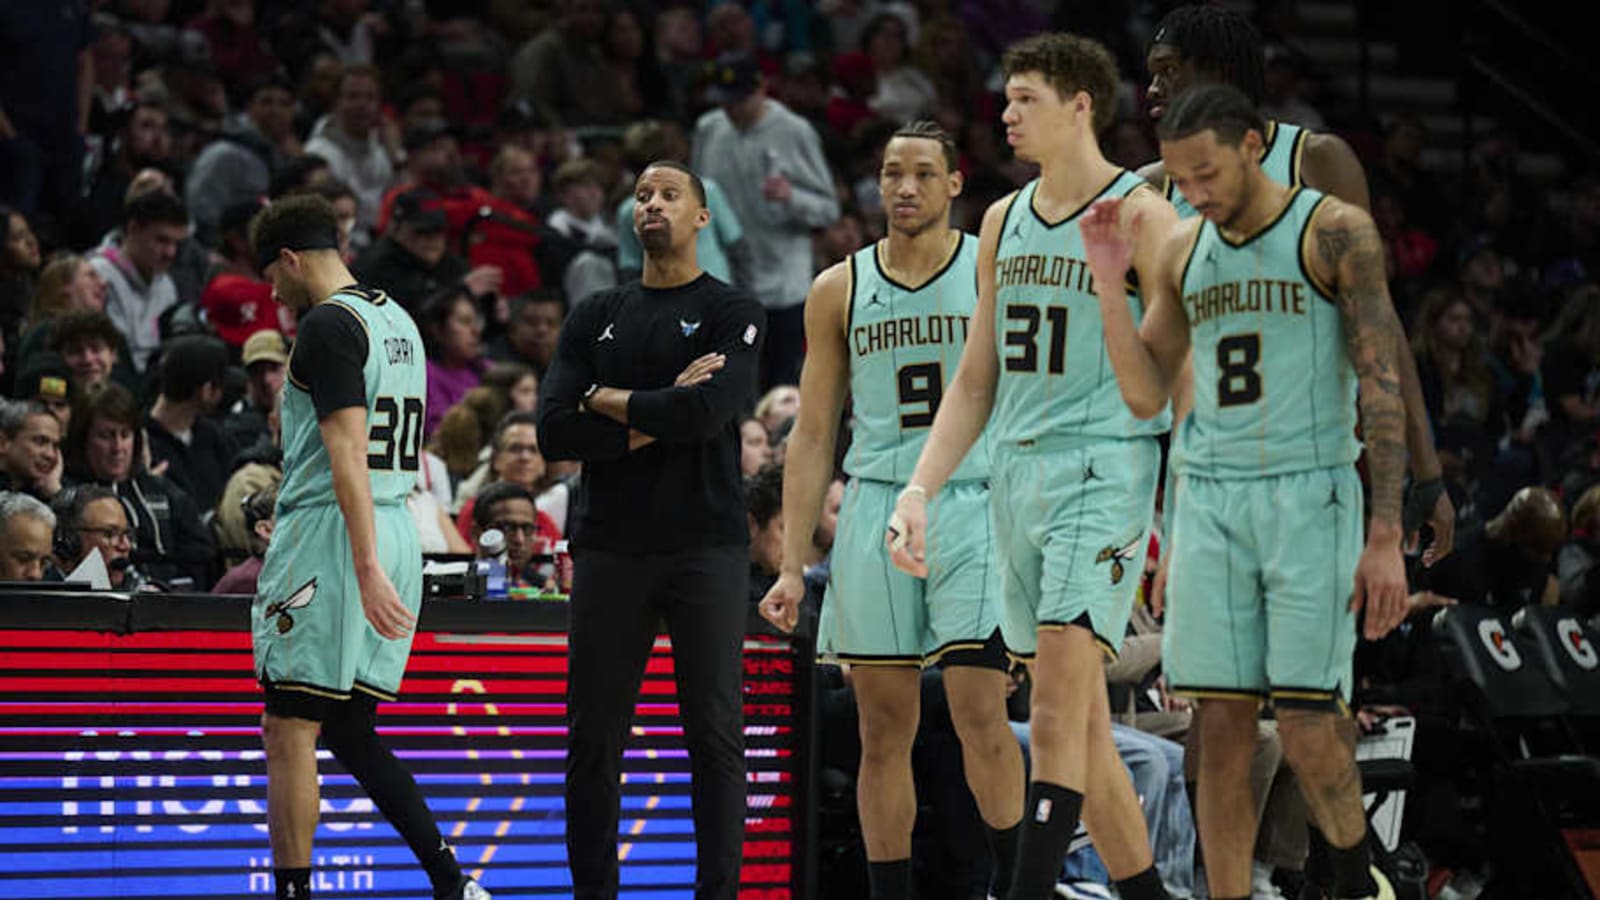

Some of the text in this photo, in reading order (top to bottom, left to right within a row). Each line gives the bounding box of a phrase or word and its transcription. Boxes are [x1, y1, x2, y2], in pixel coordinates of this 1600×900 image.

[854, 314, 971, 357] CHARLOTT
[1004, 304, 1068, 376] 31
[1216, 332, 1262, 408] 8
[897, 361, 943, 429] 9
[367, 396, 424, 471] 30
